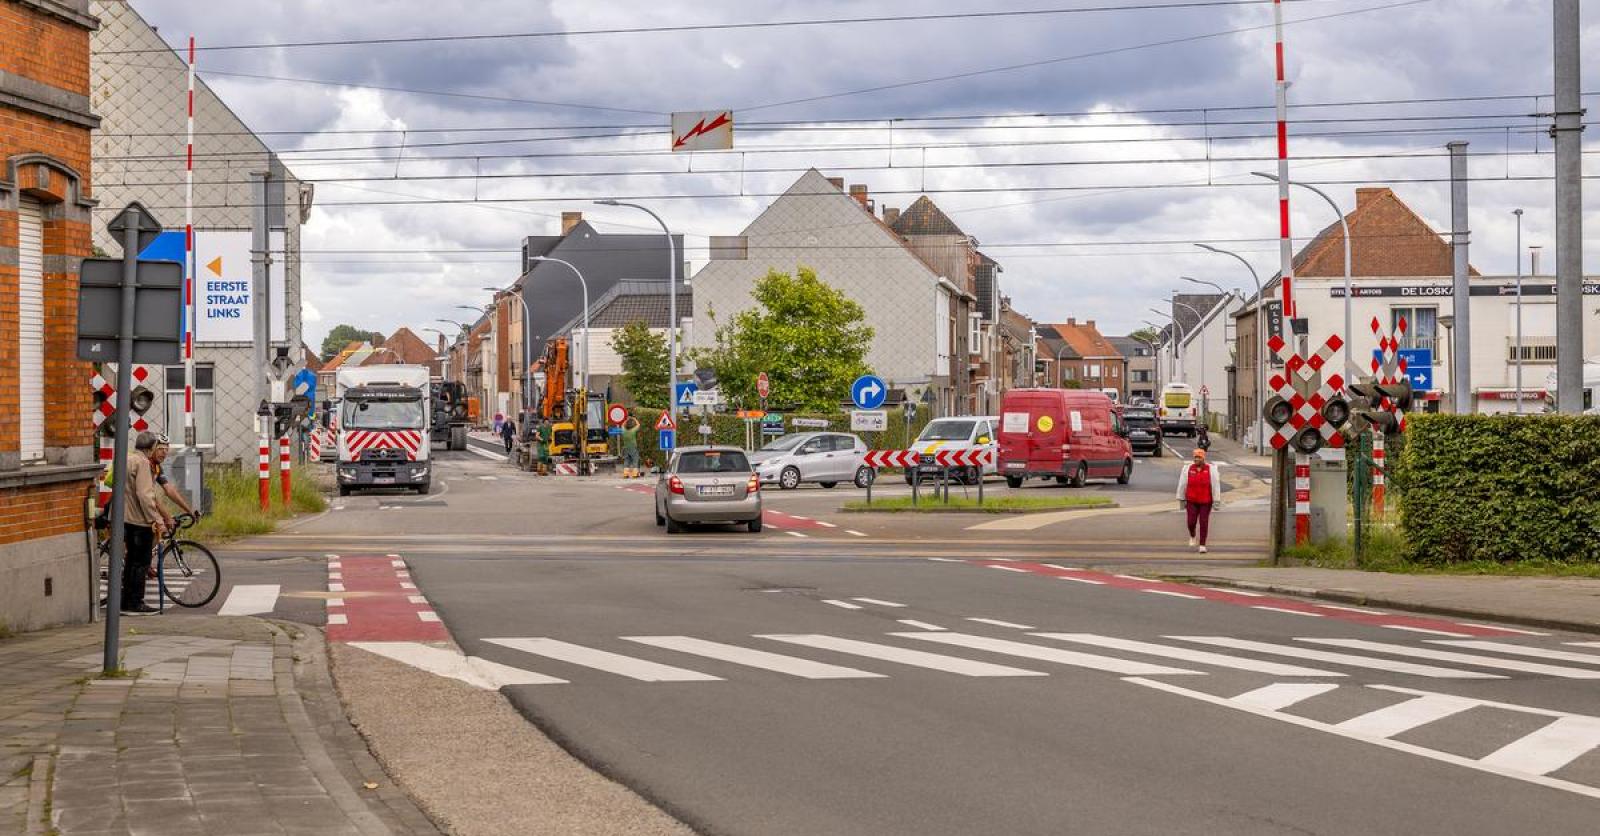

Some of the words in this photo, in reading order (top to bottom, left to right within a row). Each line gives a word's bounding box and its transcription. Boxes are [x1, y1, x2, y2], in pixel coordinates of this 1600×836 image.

[207, 282, 248, 291] EERSTE
[1401, 287, 1418, 295] DE
[207, 295, 249, 304] STRAAT
[207, 308, 240, 318] LINKS
